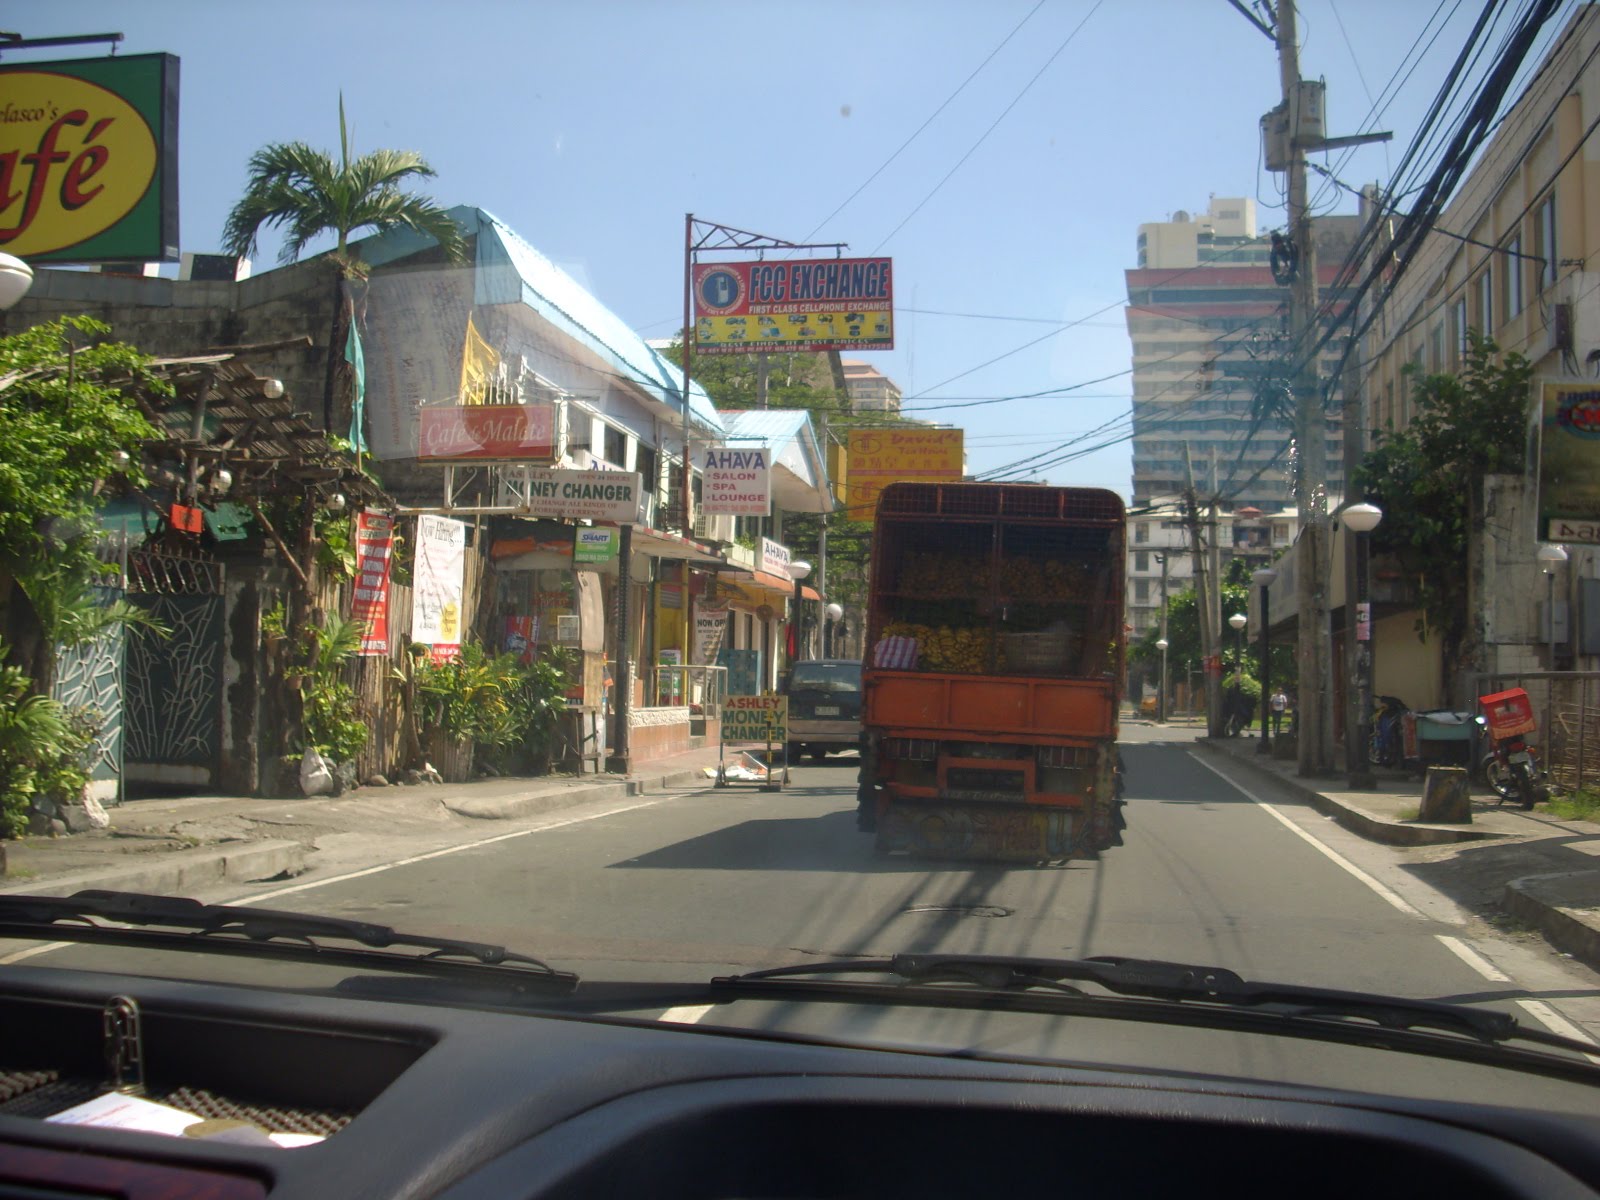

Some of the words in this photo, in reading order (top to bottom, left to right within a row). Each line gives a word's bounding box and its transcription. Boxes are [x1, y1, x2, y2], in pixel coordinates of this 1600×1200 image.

[750, 265, 787, 303] FCC
[790, 261, 890, 301] EXCHANGE
[749, 304, 771, 314] FIRST
[773, 303, 798, 313] CLASS
[800, 302, 845, 312] CELLPHONE
[847, 301, 890, 311] EXCHANGE
[481, 415, 545, 444] Malate
[705, 451, 765, 470] AHAVA
[509, 469, 555, 480] ASLEY
[712, 472, 756, 480] SALON
[562, 482, 632, 502] CHANGER
[711, 494, 765, 502] LOUNGE
[765, 542, 789, 565] AHAVA
[697, 618, 713, 628] NOW
[726, 697, 781, 709] ASHLEY
[722, 710, 785, 724] MONEY
[721, 726, 786, 740] CHANGER
